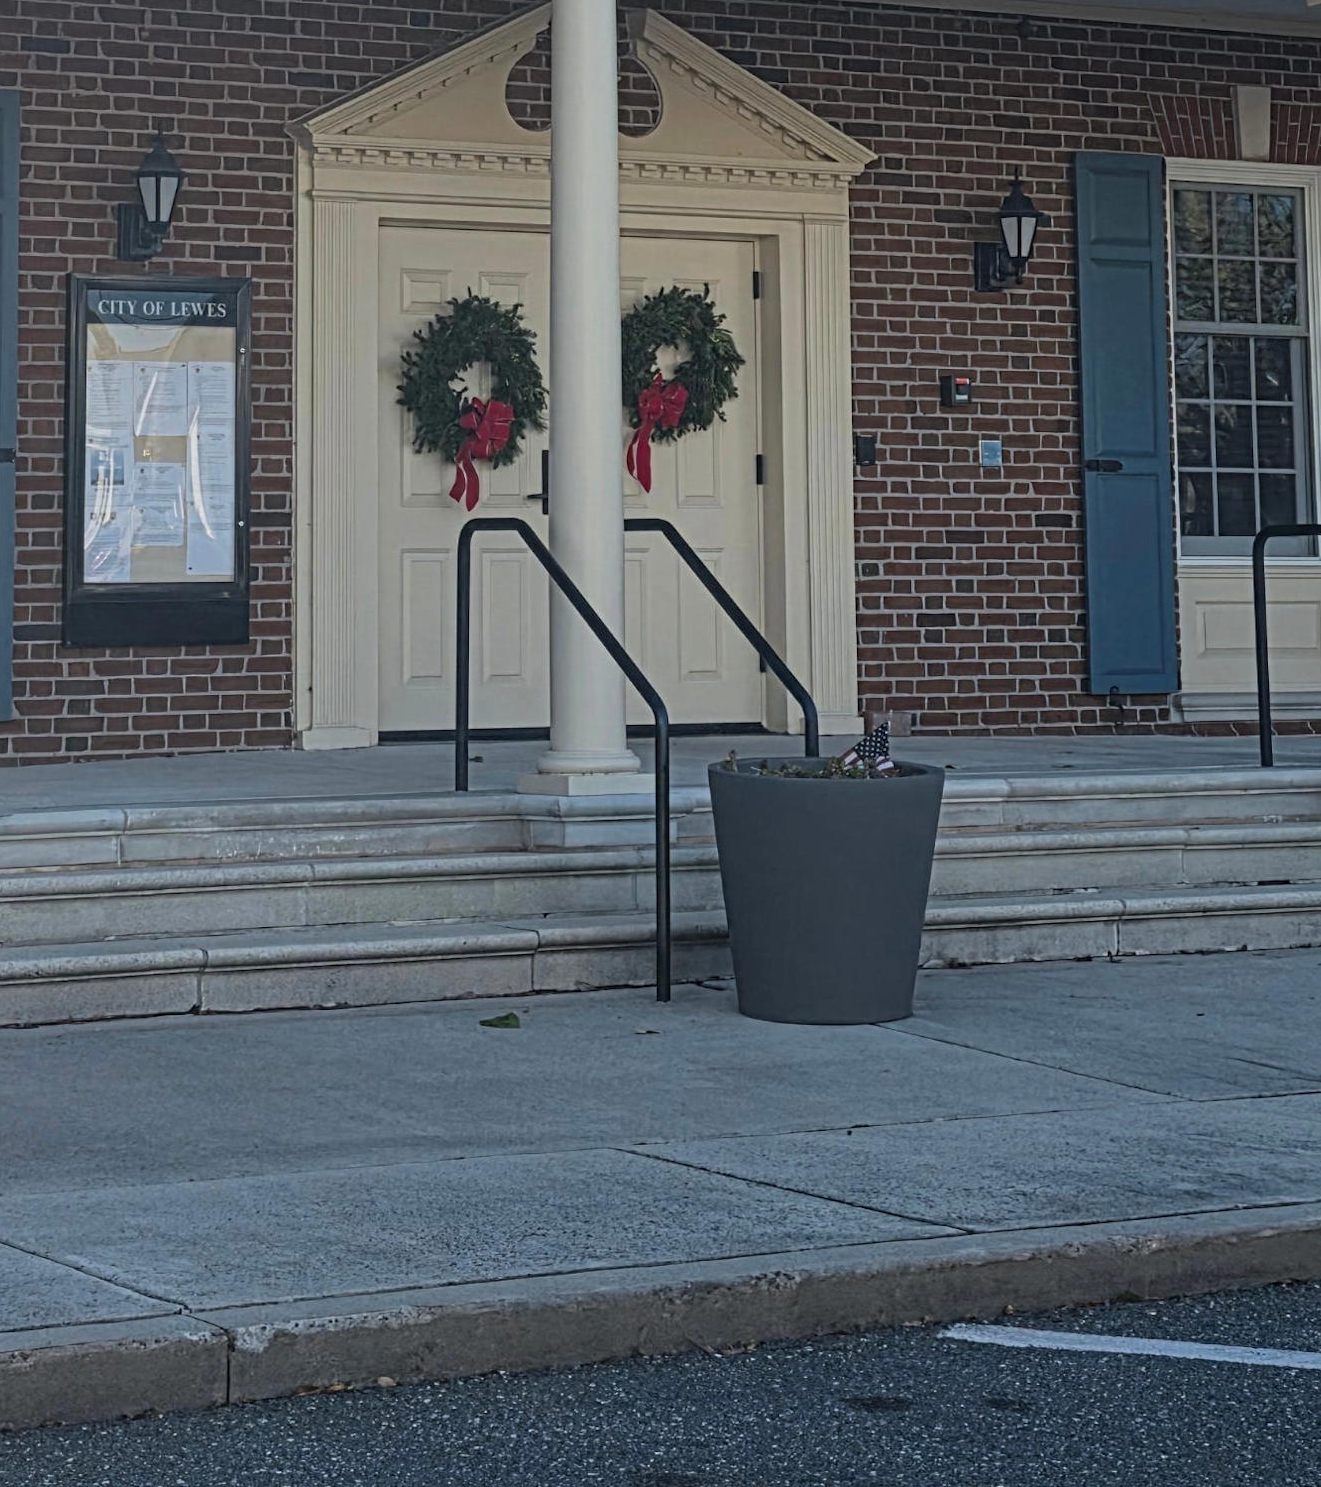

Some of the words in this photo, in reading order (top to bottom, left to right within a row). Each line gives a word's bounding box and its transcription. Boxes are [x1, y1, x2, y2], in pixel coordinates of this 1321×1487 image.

[98, 299, 137, 315] CITY
[143, 301, 165, 316] OF
[171, 301, 227, 318] LEWES
